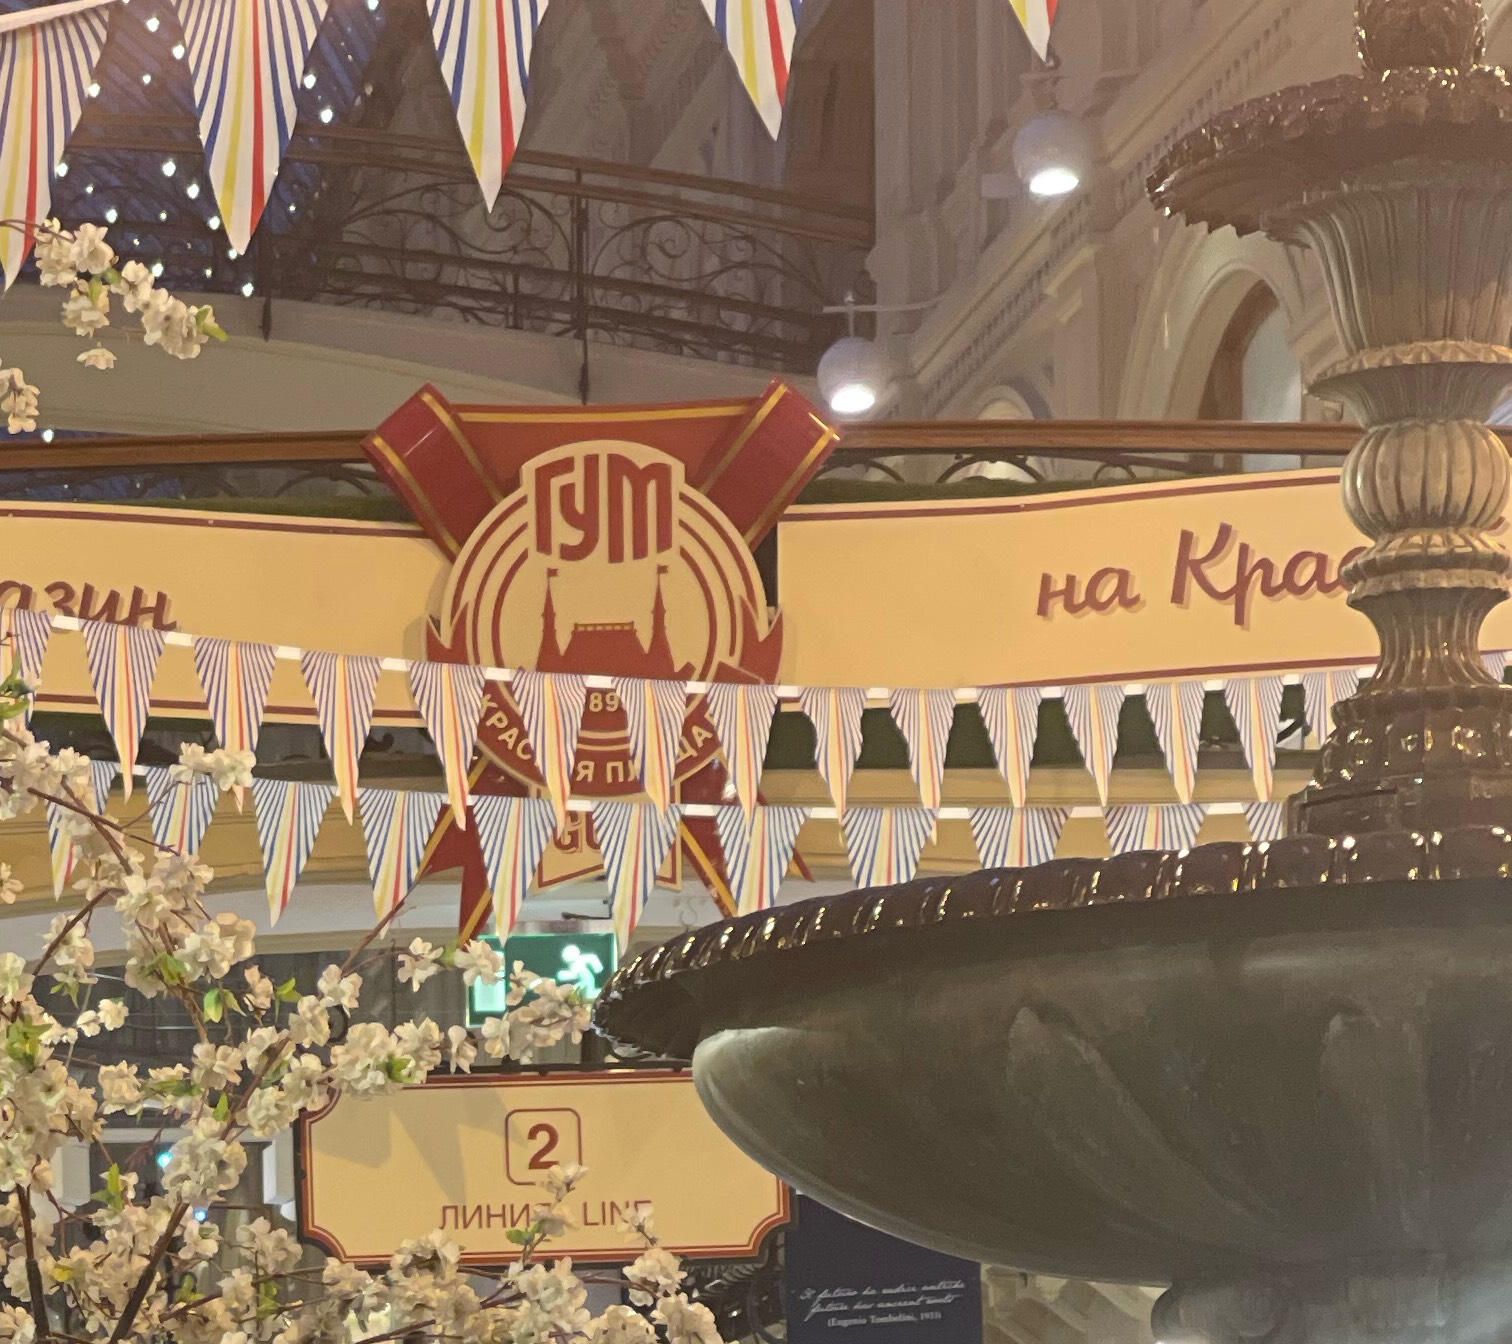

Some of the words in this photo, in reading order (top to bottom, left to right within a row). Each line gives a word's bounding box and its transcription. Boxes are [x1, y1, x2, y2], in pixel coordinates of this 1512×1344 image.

[534, 453, 673, 564] ГУМ
[1036, 566, 1141, 618] на
[527, 1122, 560, 1171] 2
[438, 1203, 551, 1230] ЛИНИ
